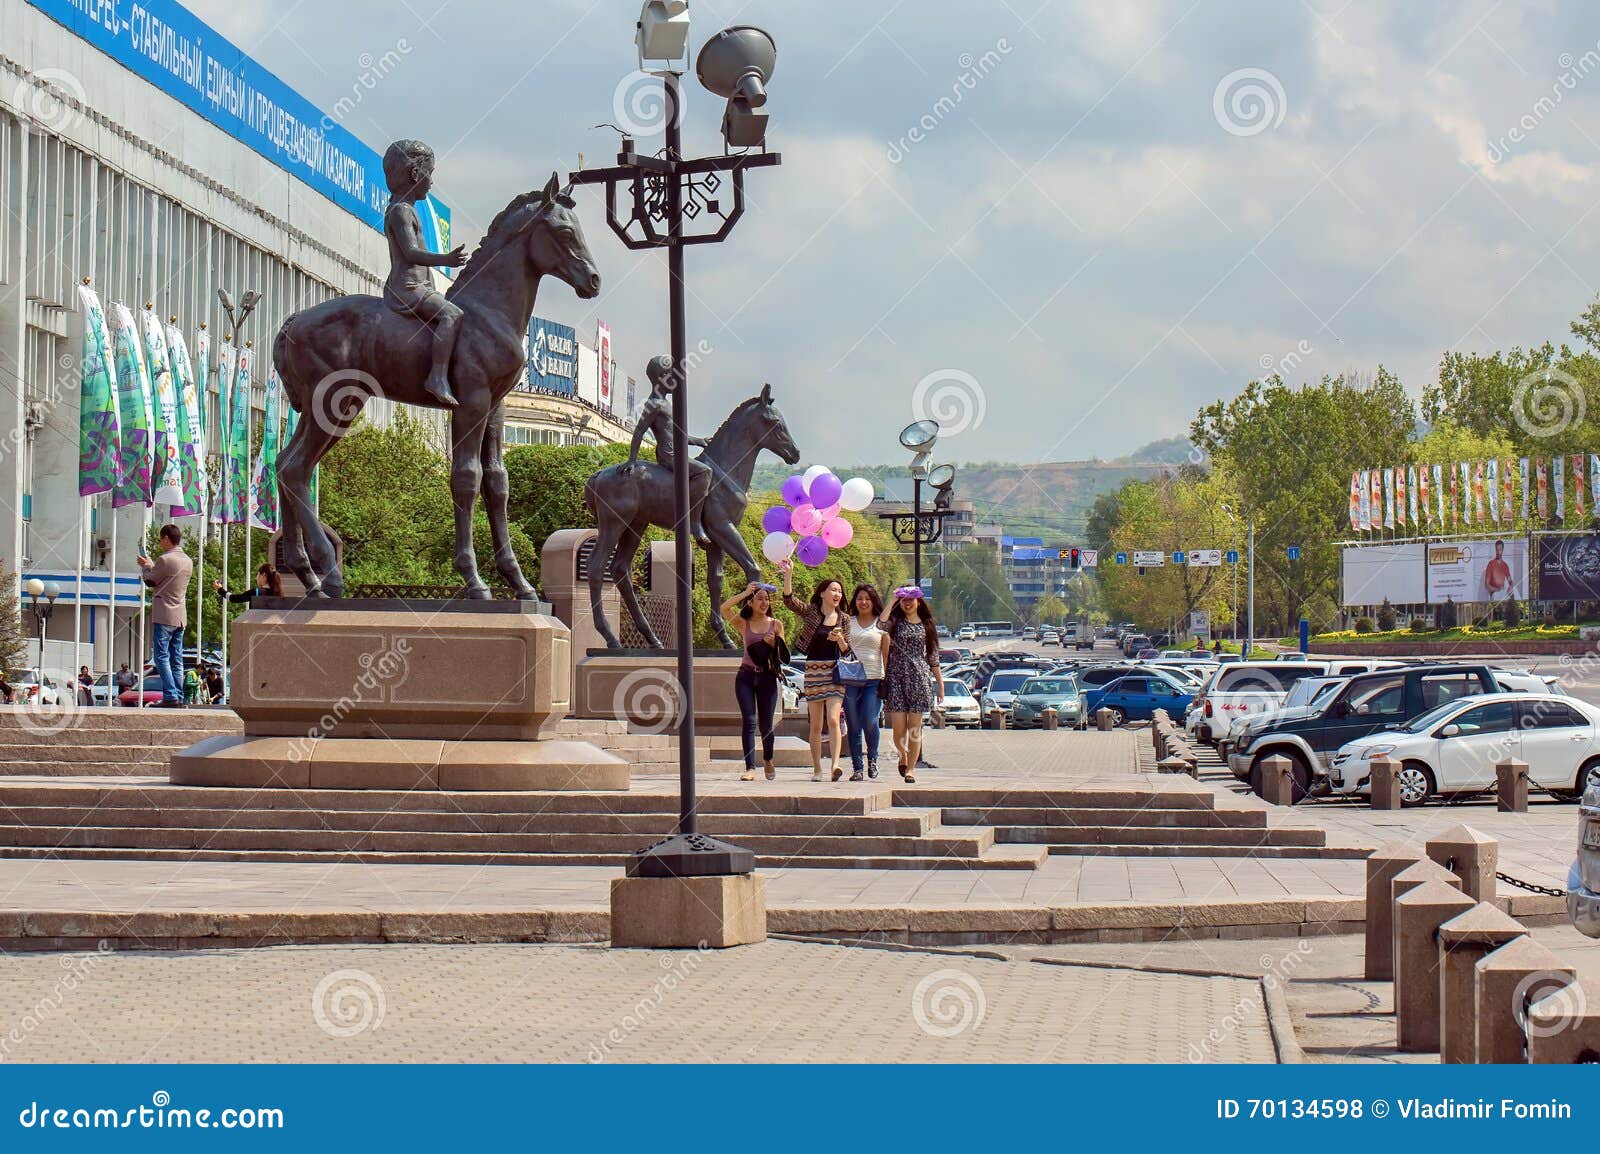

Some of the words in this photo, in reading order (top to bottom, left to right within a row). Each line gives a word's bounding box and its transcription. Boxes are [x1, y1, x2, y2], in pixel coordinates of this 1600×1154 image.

[131, 3, 205, 102] СТАБИЛЬНЫЙ,
[206, 55, 246, 122] ЕДИНЫЙ
[248, 86, 255, 128] И
[256, 91, 325, 176] ПРОЦВЕТАЮЩИЙ
